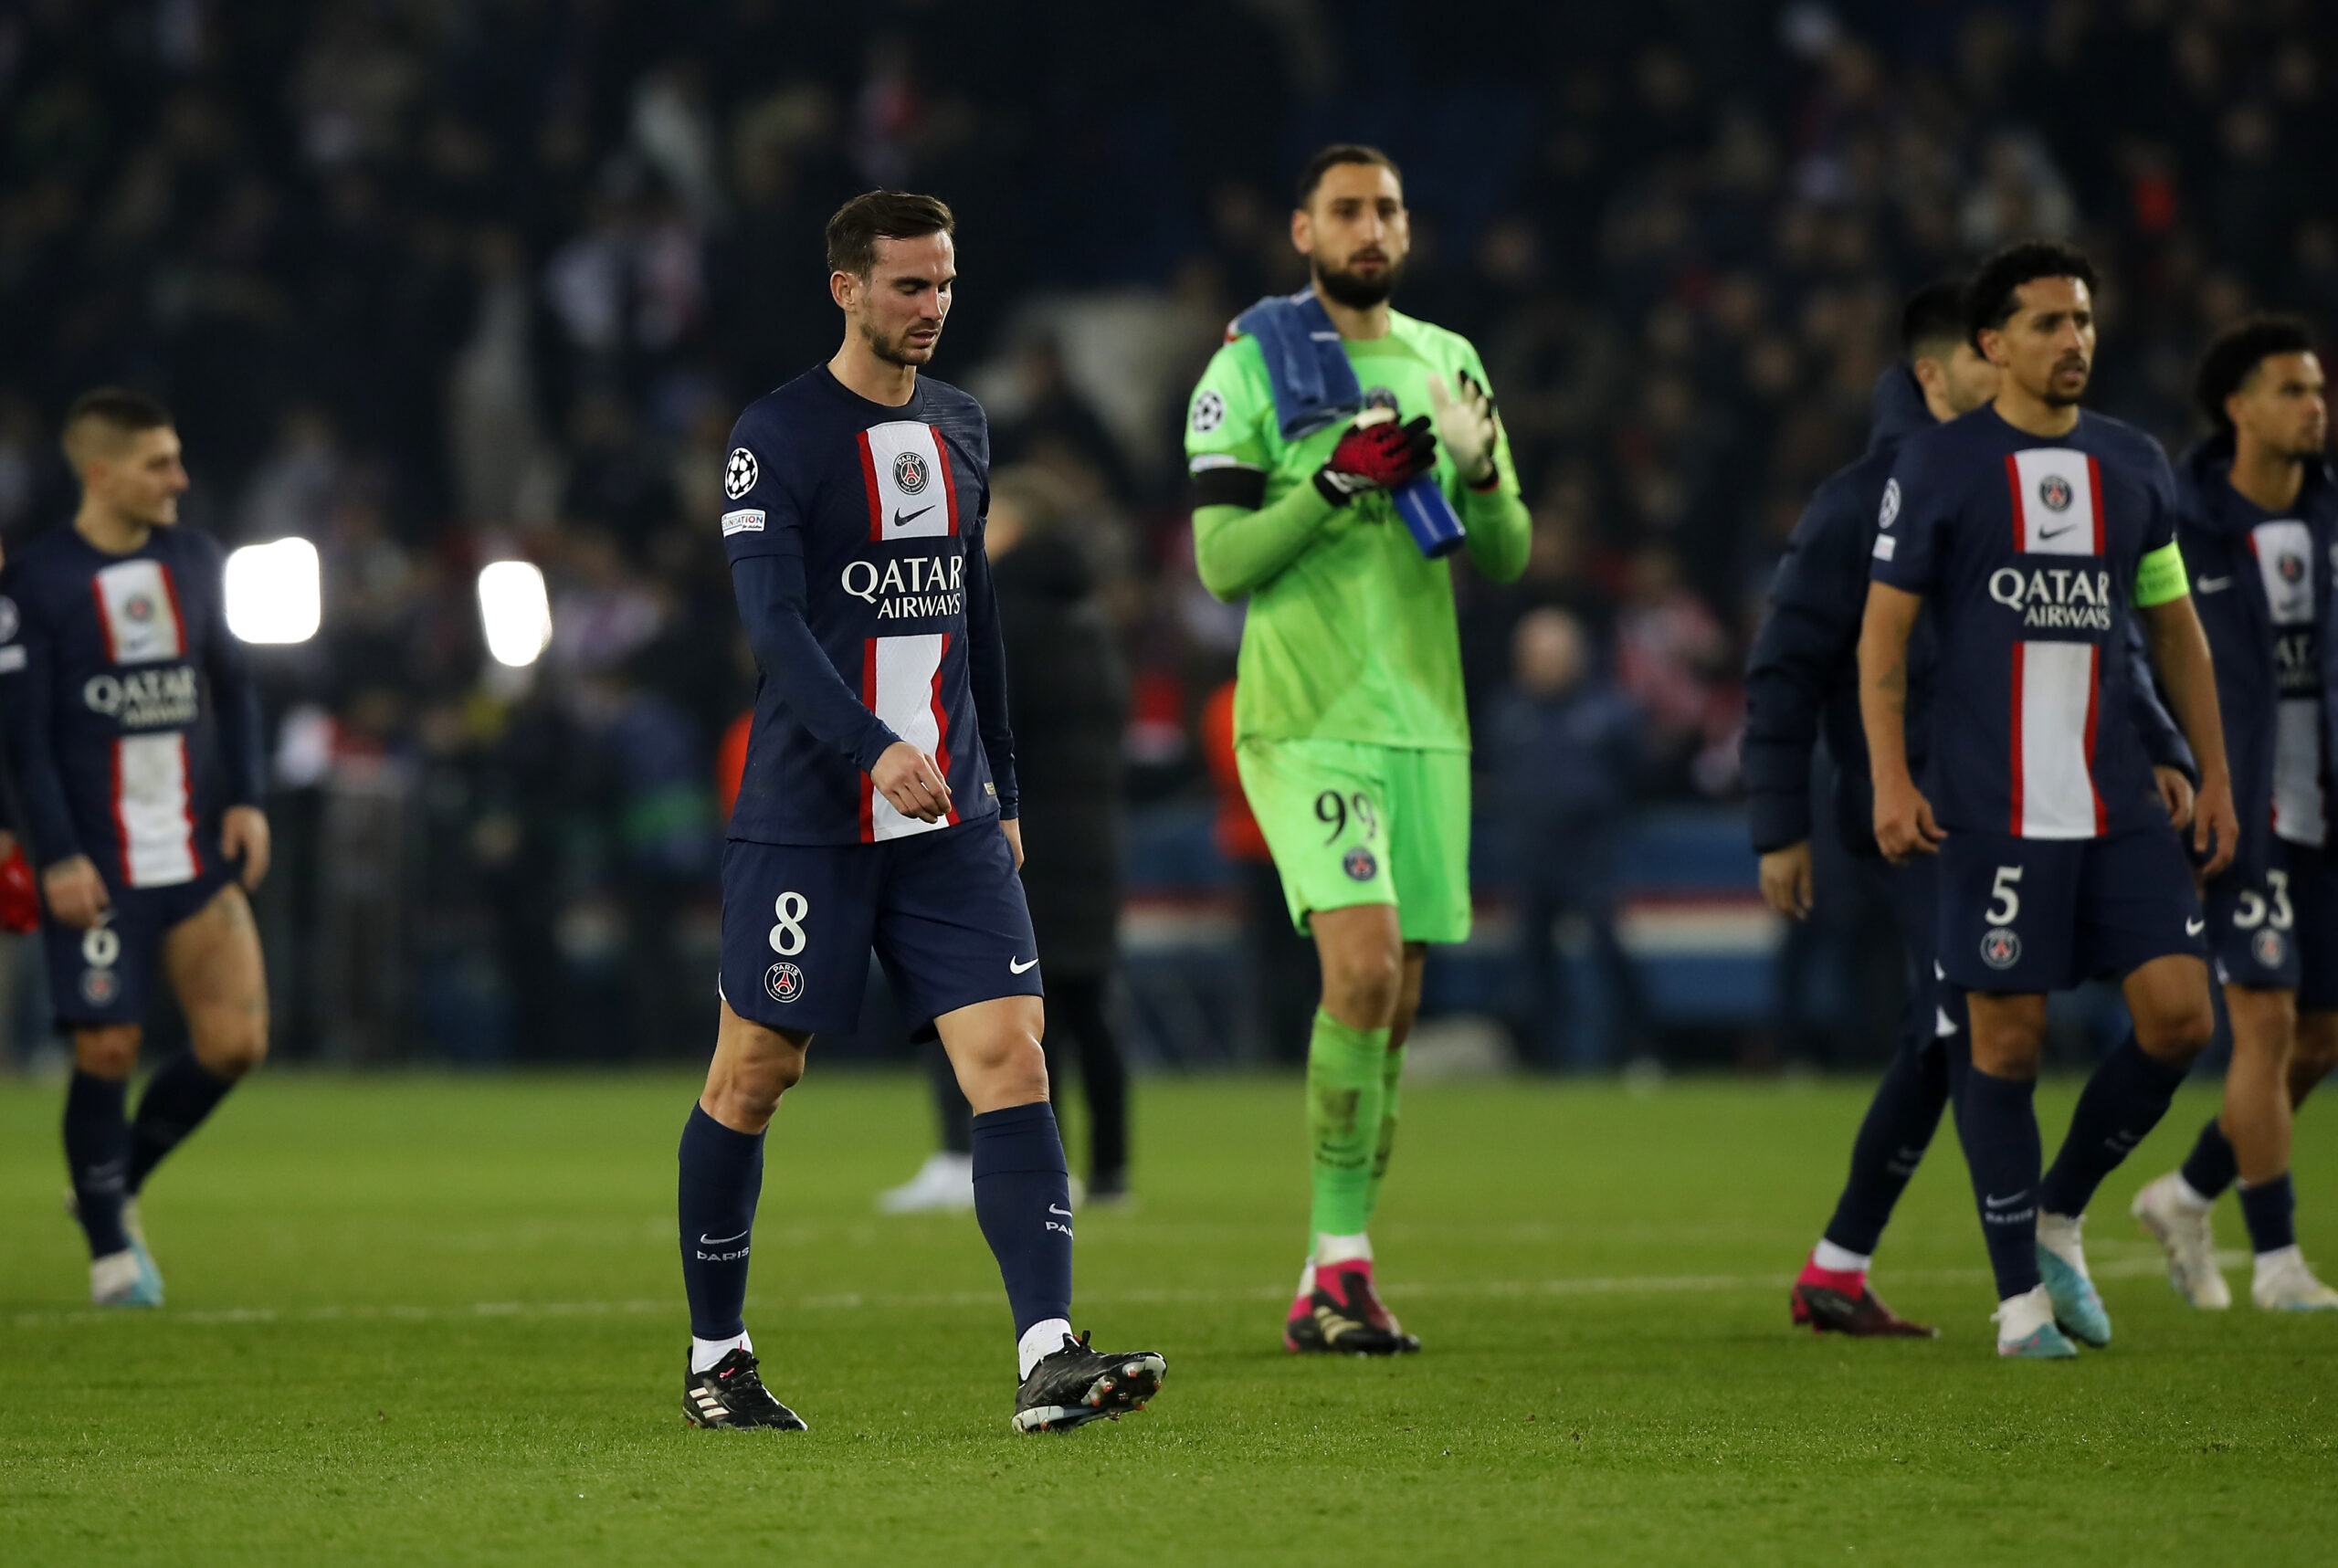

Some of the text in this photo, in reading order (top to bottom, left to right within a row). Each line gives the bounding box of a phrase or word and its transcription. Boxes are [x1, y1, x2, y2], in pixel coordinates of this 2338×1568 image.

[897, 455, 921, 466] PARIS
[841, 555, 964, 605] QATAR
[1988, 567, 2111, 612] QATAR
[877, 593, 962, 619] AIRWAYS
[2023, 604, 2112, 631] AIRWAYS
[1313, 790, 1376, 847] 99
[1985, 864, 2024, 926] 5
[768, 890, 809, 957] 8
[773, 964, 800, 977] PARIS
[696, 1247, 750, 1261] PARIS
